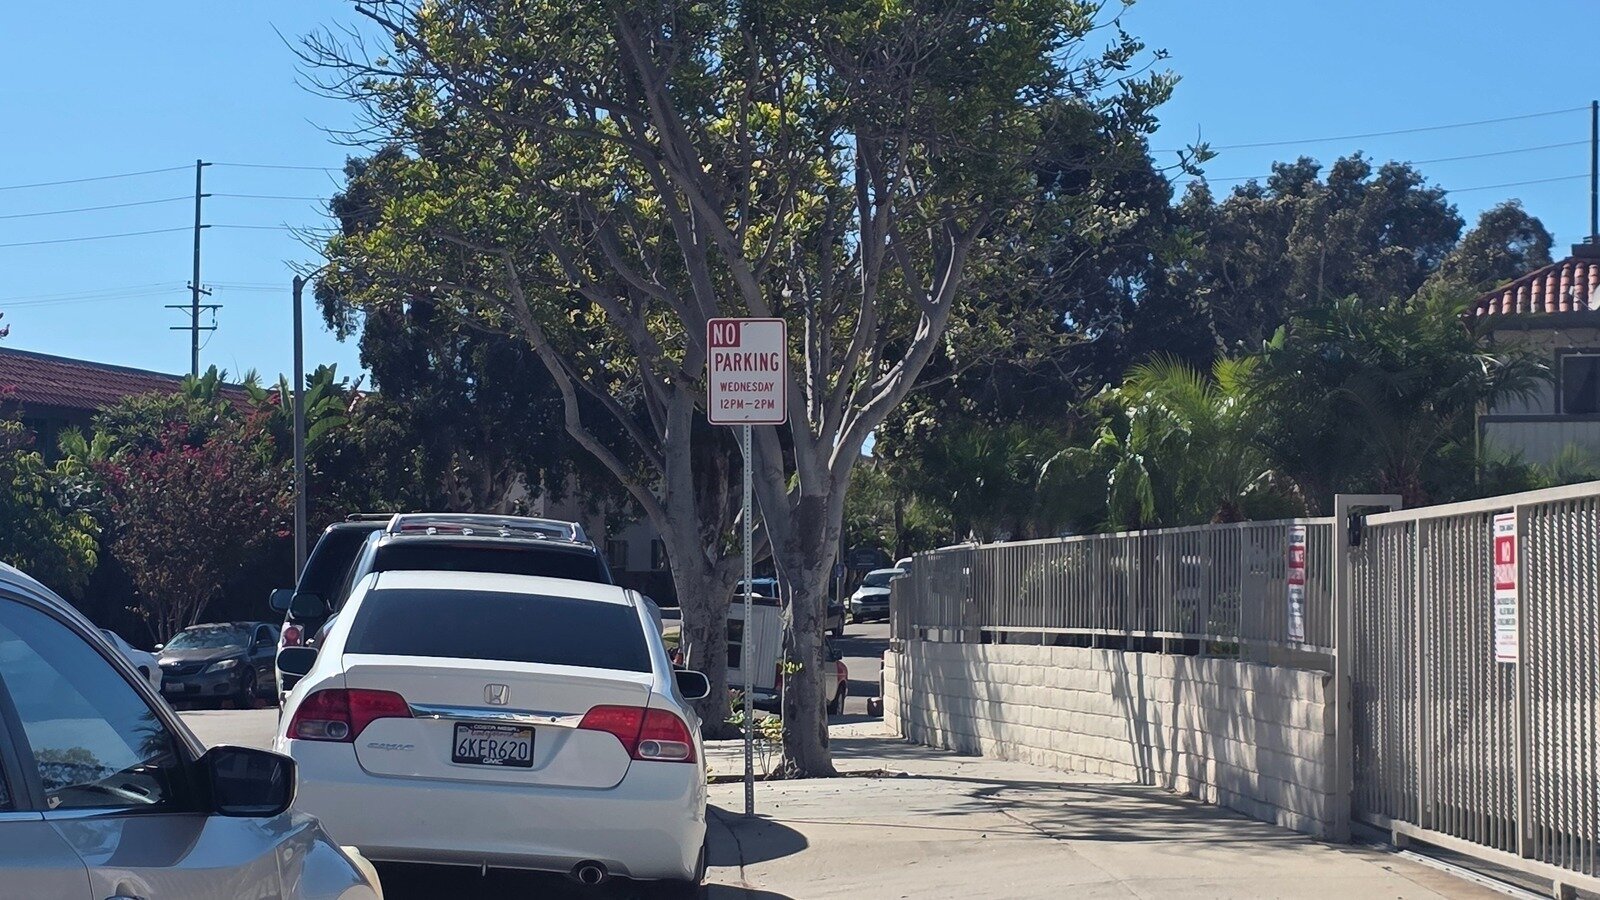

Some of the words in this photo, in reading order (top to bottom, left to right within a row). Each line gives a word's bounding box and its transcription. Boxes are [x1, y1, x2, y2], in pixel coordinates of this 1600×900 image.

[713, 323, 736, 345] NO
[715, 352, 779, 372] PARKING
[720, 382, 775, 392] WEDNESDAY
[458, 738, 528, 760] 6KER620
